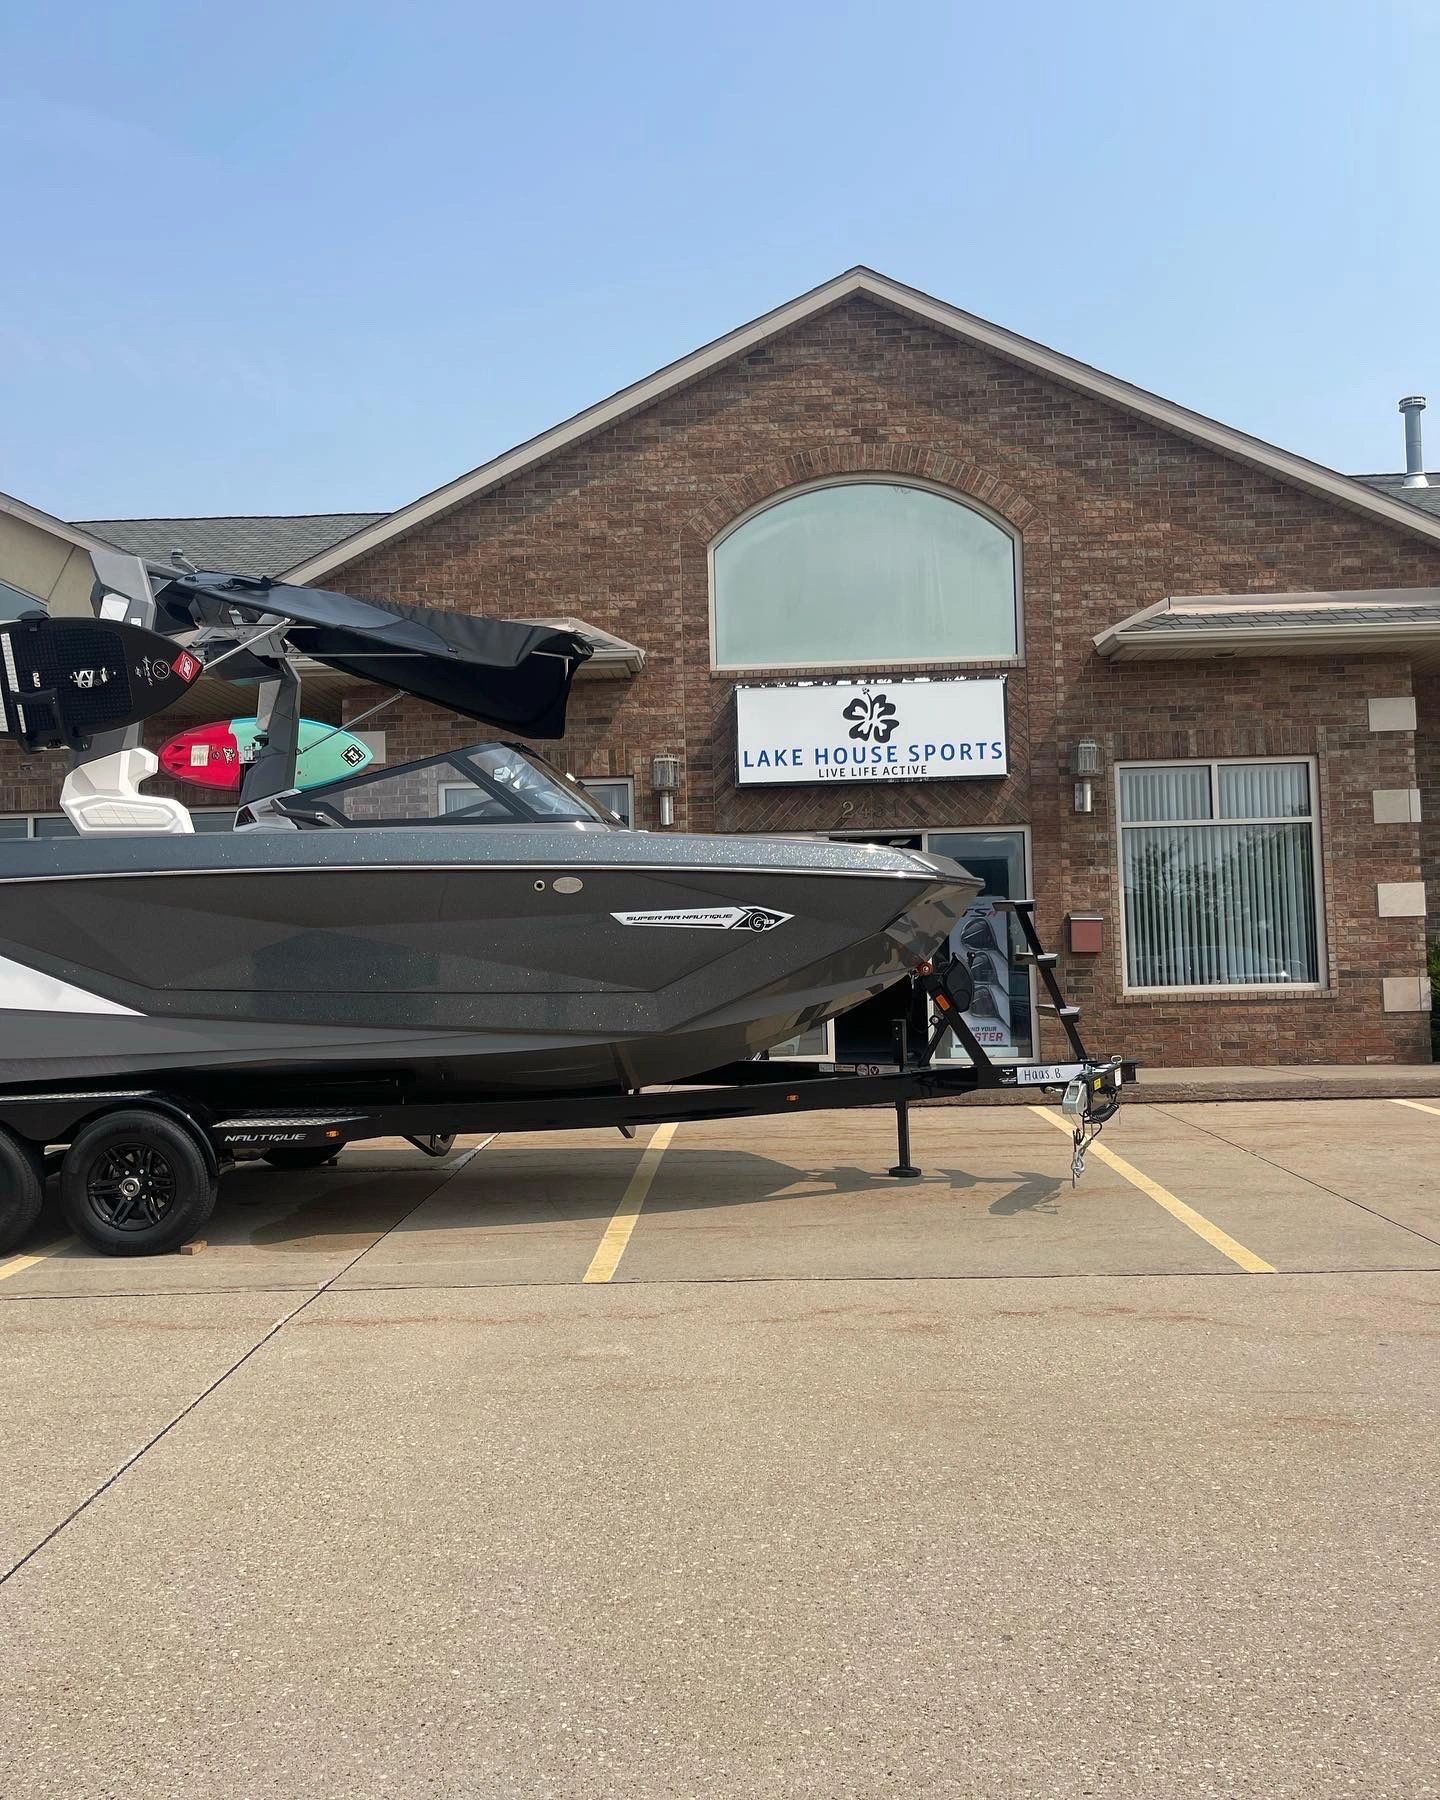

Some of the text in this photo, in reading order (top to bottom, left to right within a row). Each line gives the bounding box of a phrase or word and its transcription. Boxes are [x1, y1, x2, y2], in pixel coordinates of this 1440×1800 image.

[743, 742, 1004, 768] LAKE HOUSE SPORTS
[818, 765, 928, 779] LIVE LIFE ACTIVE
[975, 1032, 1004, 1042] STER
[224, 1133, 307, 1142] NAUTIQUE
